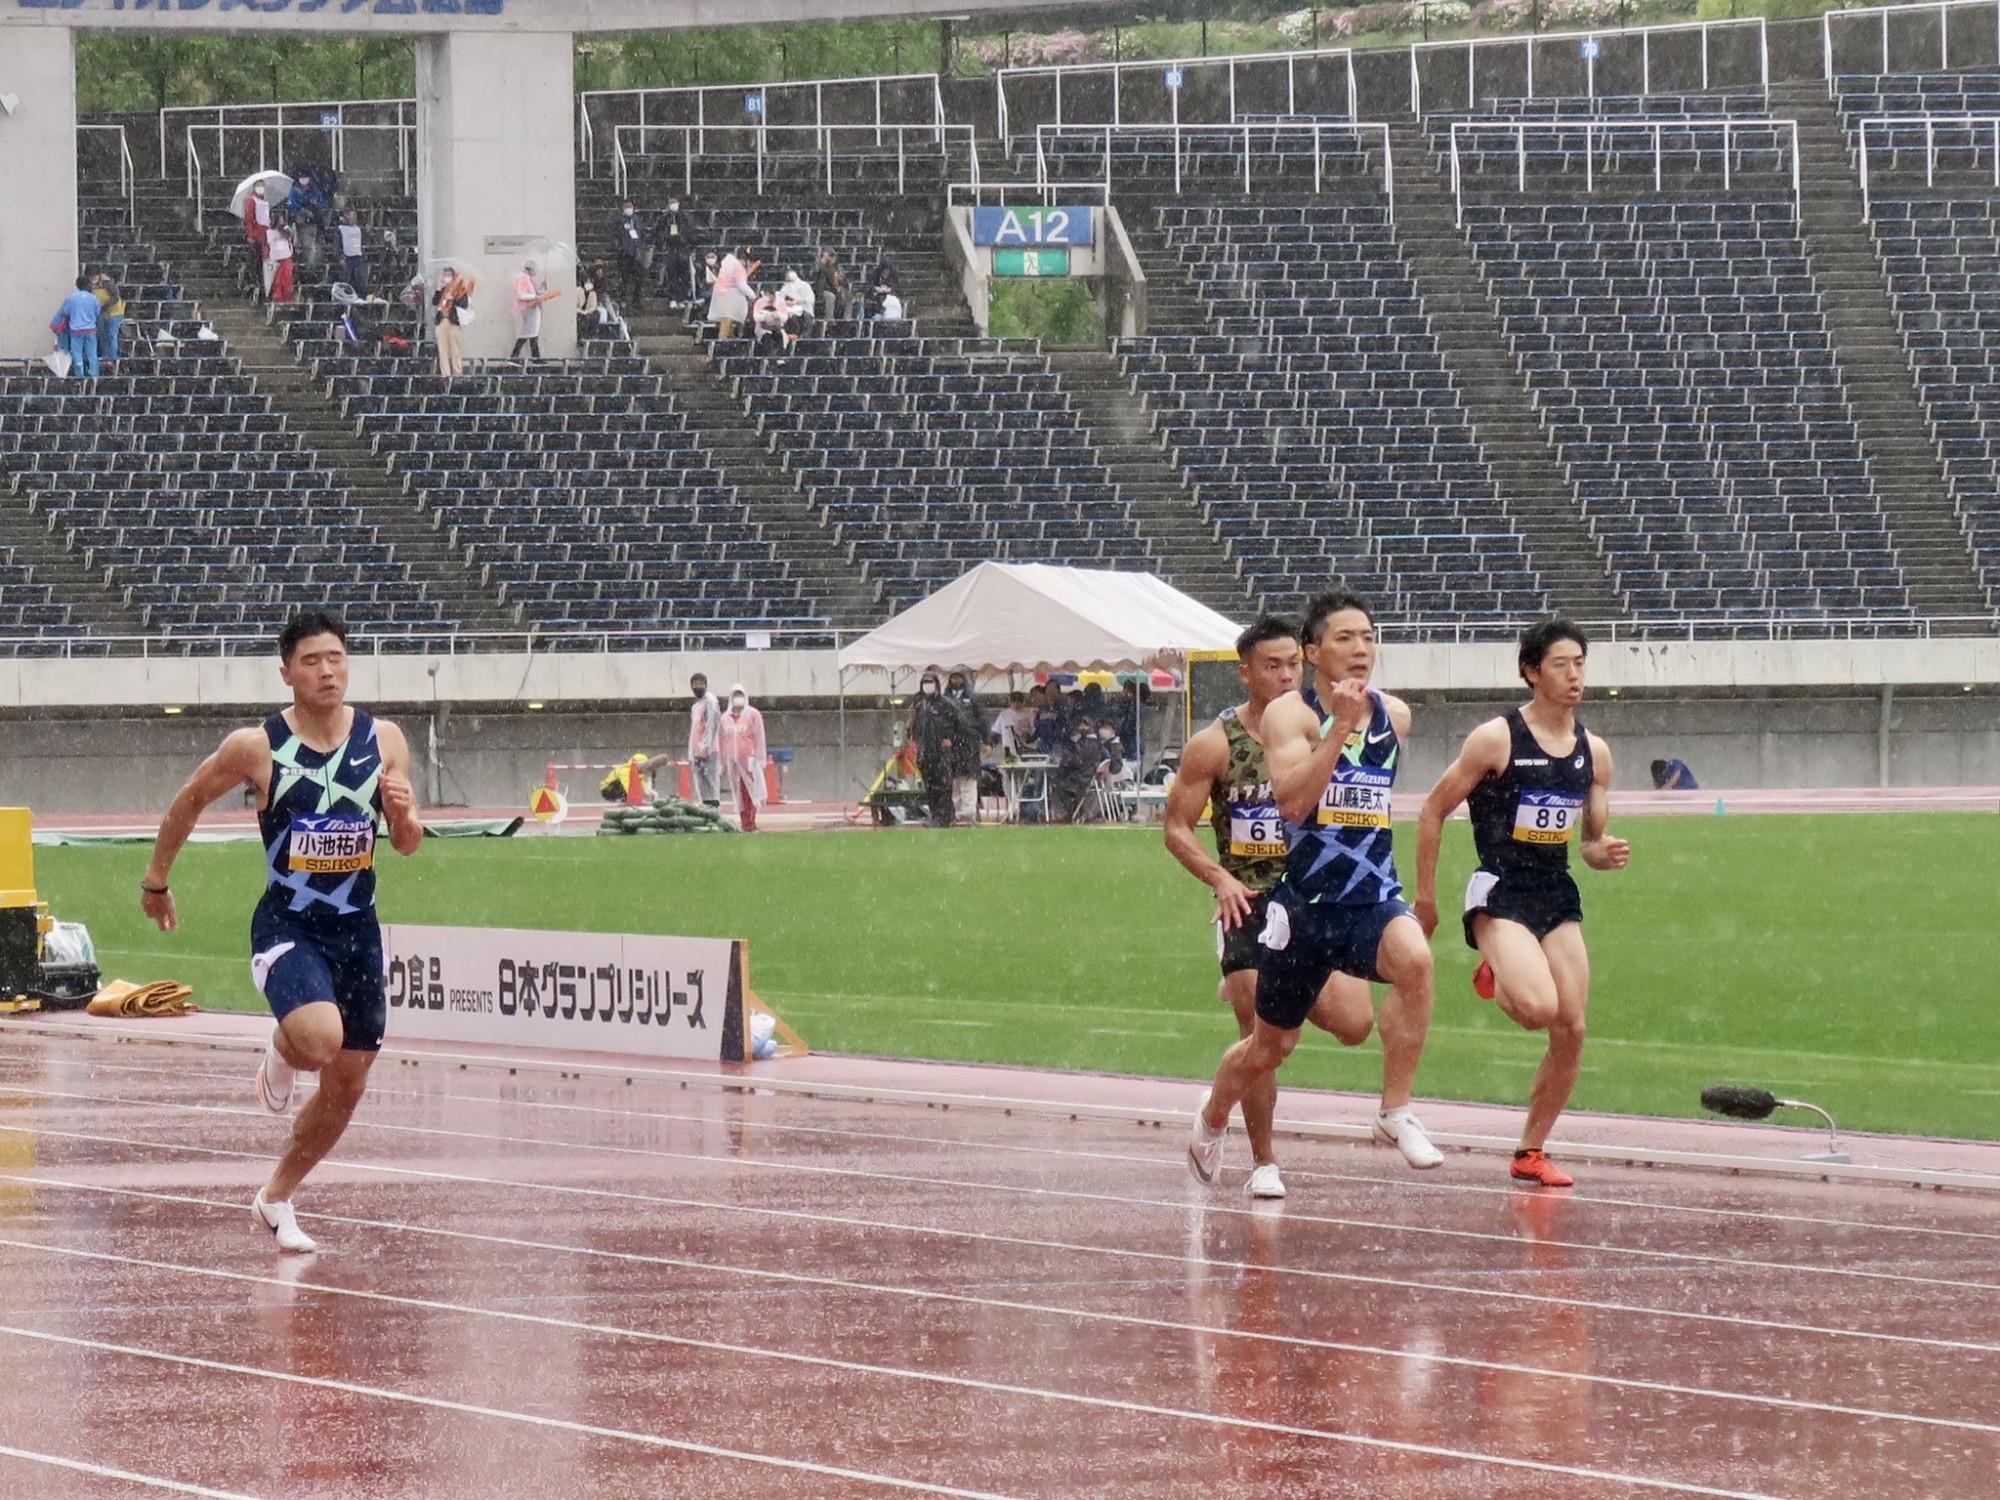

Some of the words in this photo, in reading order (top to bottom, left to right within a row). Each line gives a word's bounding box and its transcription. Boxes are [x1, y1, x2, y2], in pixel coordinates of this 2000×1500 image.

[748, 97, 761, 112] 81
[994, 210, 1069, 242] A12
[1325, 784, 1384, 811] 山縣亮太
[1332, 812, 1379, 826] SEIKO
[1535, 808, 1567, 829] 89
[298, 833, 369, 856] 小池祐貴
[305, 858, 361, 871] SEIKO
[384, 954, 444, 1011] ウ食品
[450, 989, 493, 1014] PRESENTS
[499, 958, 707, 1029] 日本グランプリシリーズ
